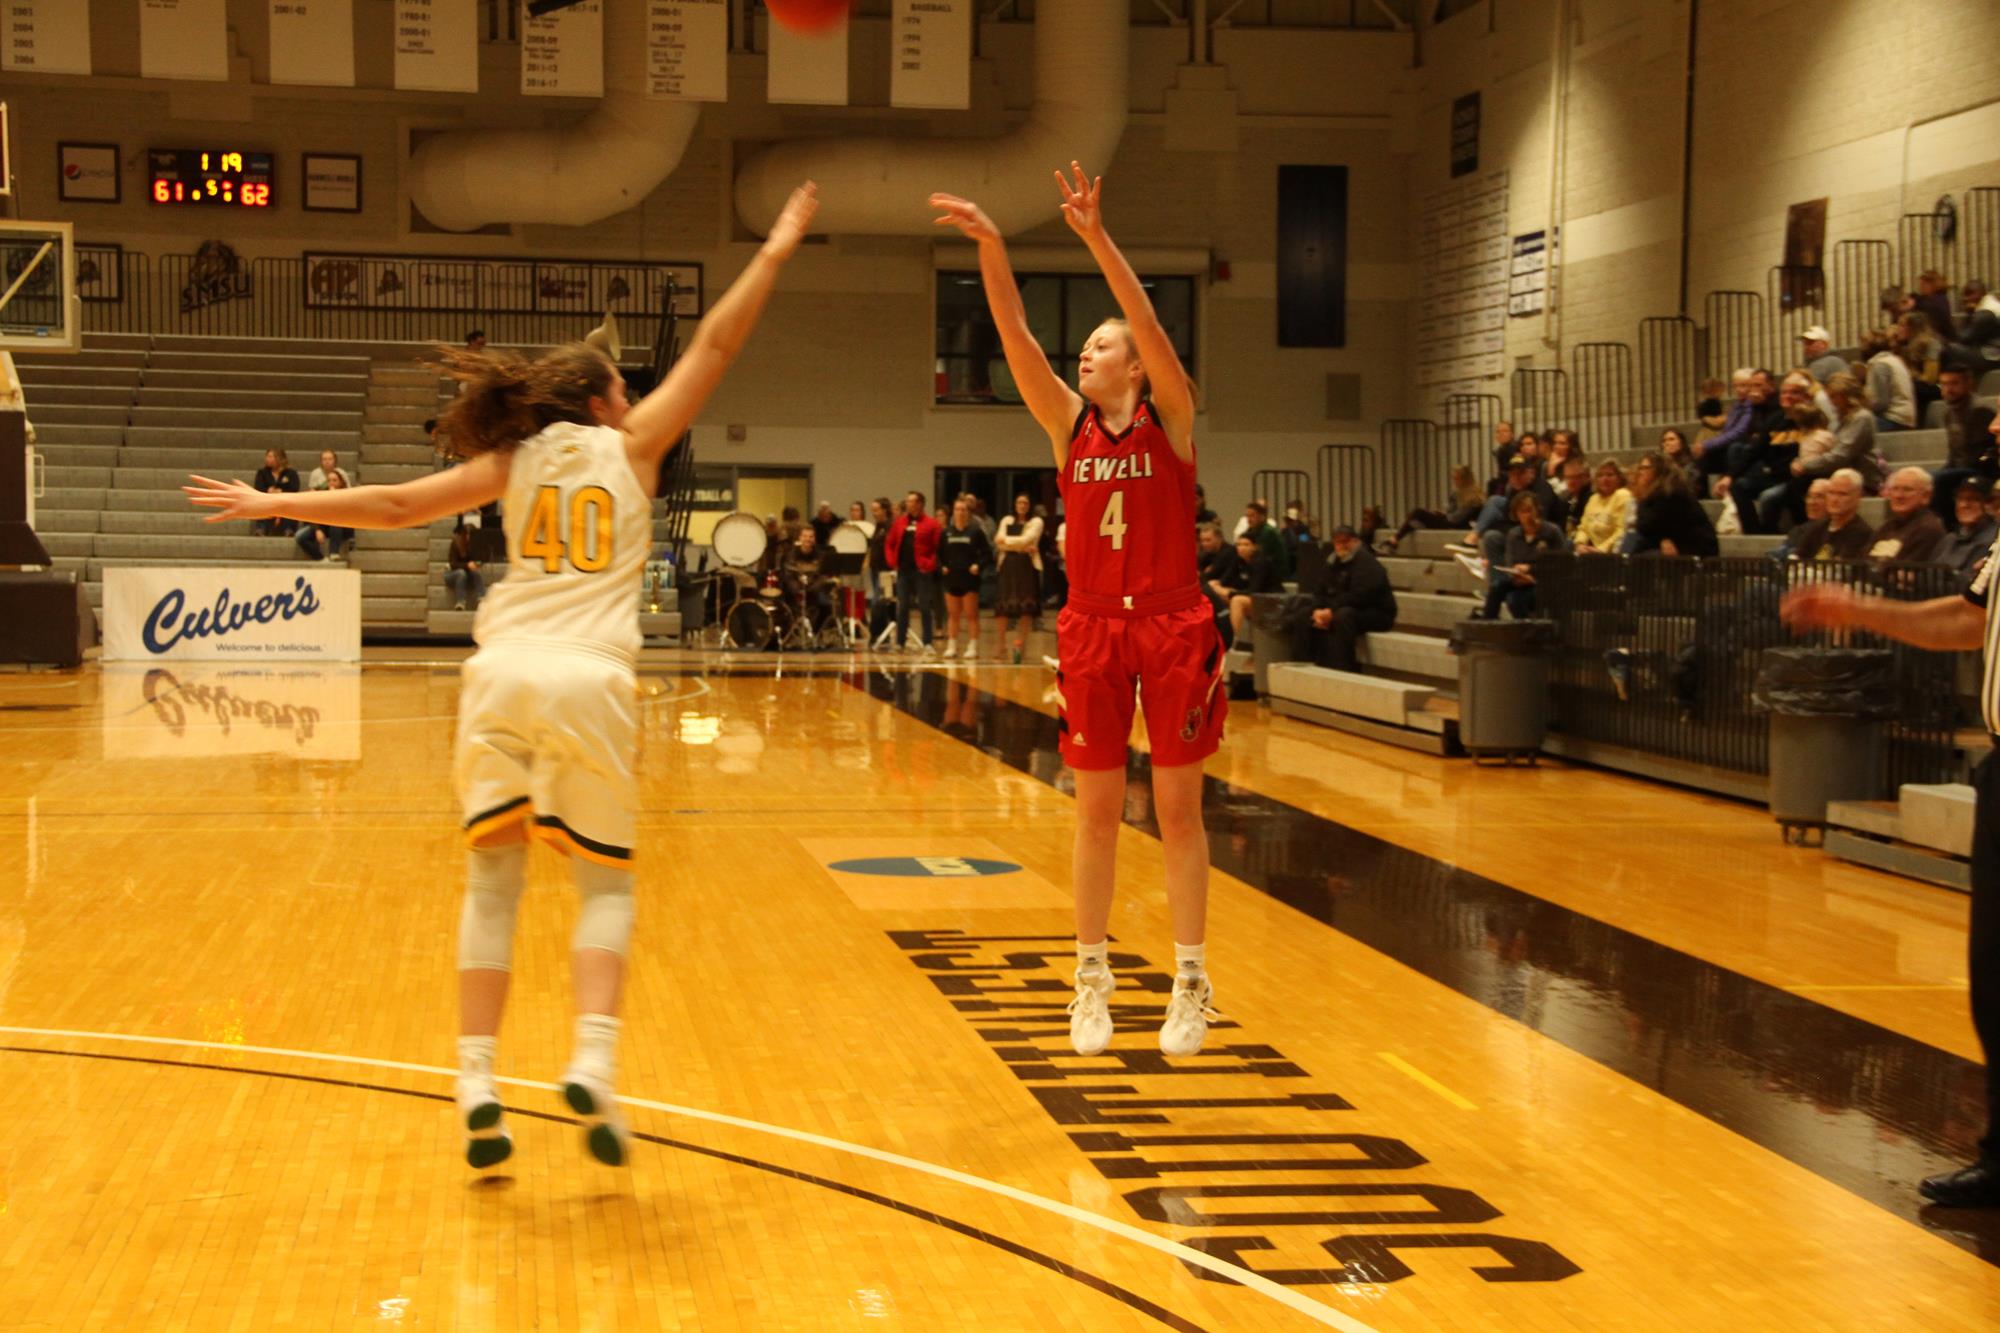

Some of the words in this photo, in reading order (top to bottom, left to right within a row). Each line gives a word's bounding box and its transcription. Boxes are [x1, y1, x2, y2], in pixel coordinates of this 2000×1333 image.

[911, 3, 952, 13] BASEBALL
[153, 178, 184, 203] 61
[240, 182, 271, 207] 62
[521, 483, 614, 574] 40
[1099, 490, 1128, 550] 4
[142, 576, 320, 655] Culver's
[216, 643, 263, 652] Welcome
[265, 643, 276, 652] to
[883, 929, 1584, 1285] SOUTHWEST
